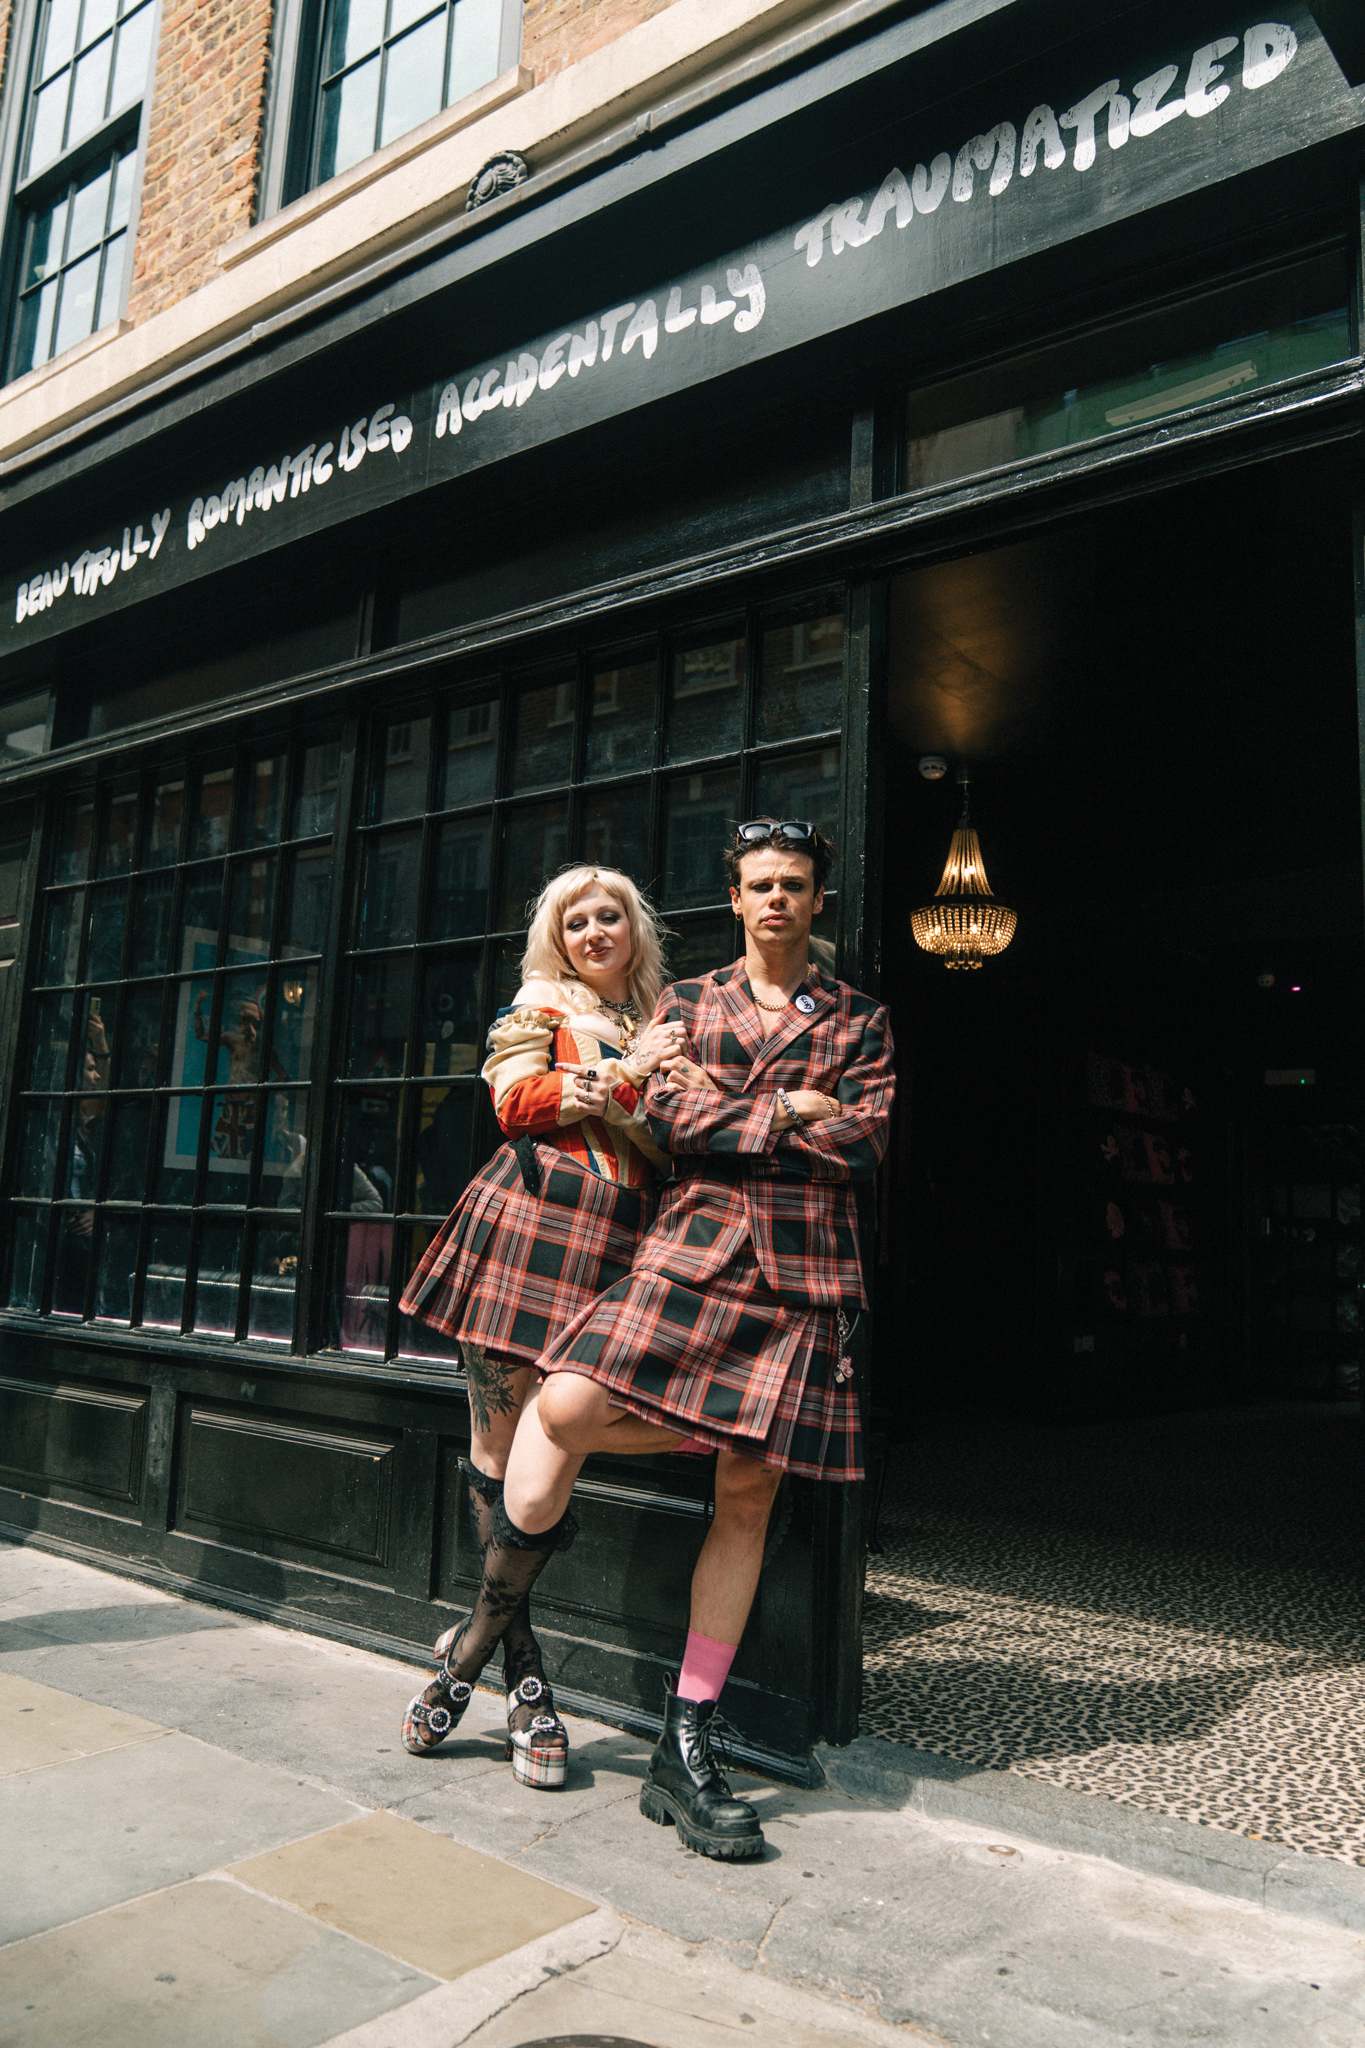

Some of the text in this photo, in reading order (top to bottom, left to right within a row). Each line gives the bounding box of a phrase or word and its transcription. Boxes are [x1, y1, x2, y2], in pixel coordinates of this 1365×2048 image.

[15, 22, 1298, 623] BEAUTIFULLY ROMANTICISED ACCIDENTALLY TRAUMATIZED
